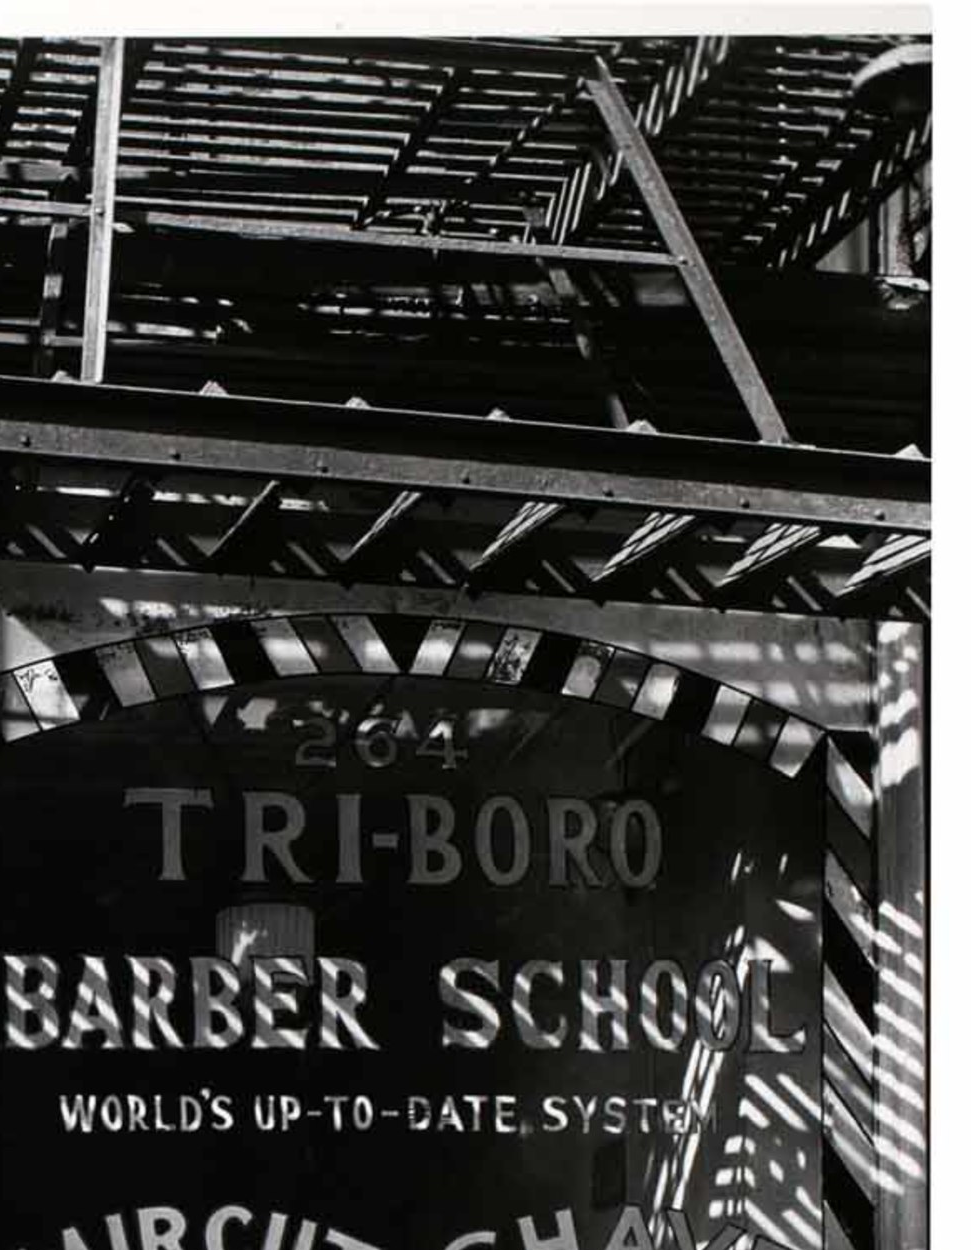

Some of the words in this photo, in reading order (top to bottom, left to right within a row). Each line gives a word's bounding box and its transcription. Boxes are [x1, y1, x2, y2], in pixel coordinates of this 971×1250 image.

[294, 716, 469, 770] 264
[123, 787, 663, 889] TRI-BORO
[3, 953, 381, 1052] BARBER
[438, 956, 808, 1054] SCHOOL
[59, 1087, 233, 1134] WORLD'S
[254, 1092, 517, 1134] UP-TO-DATE
[541, 1094, 717, 1136] SYSTEM
